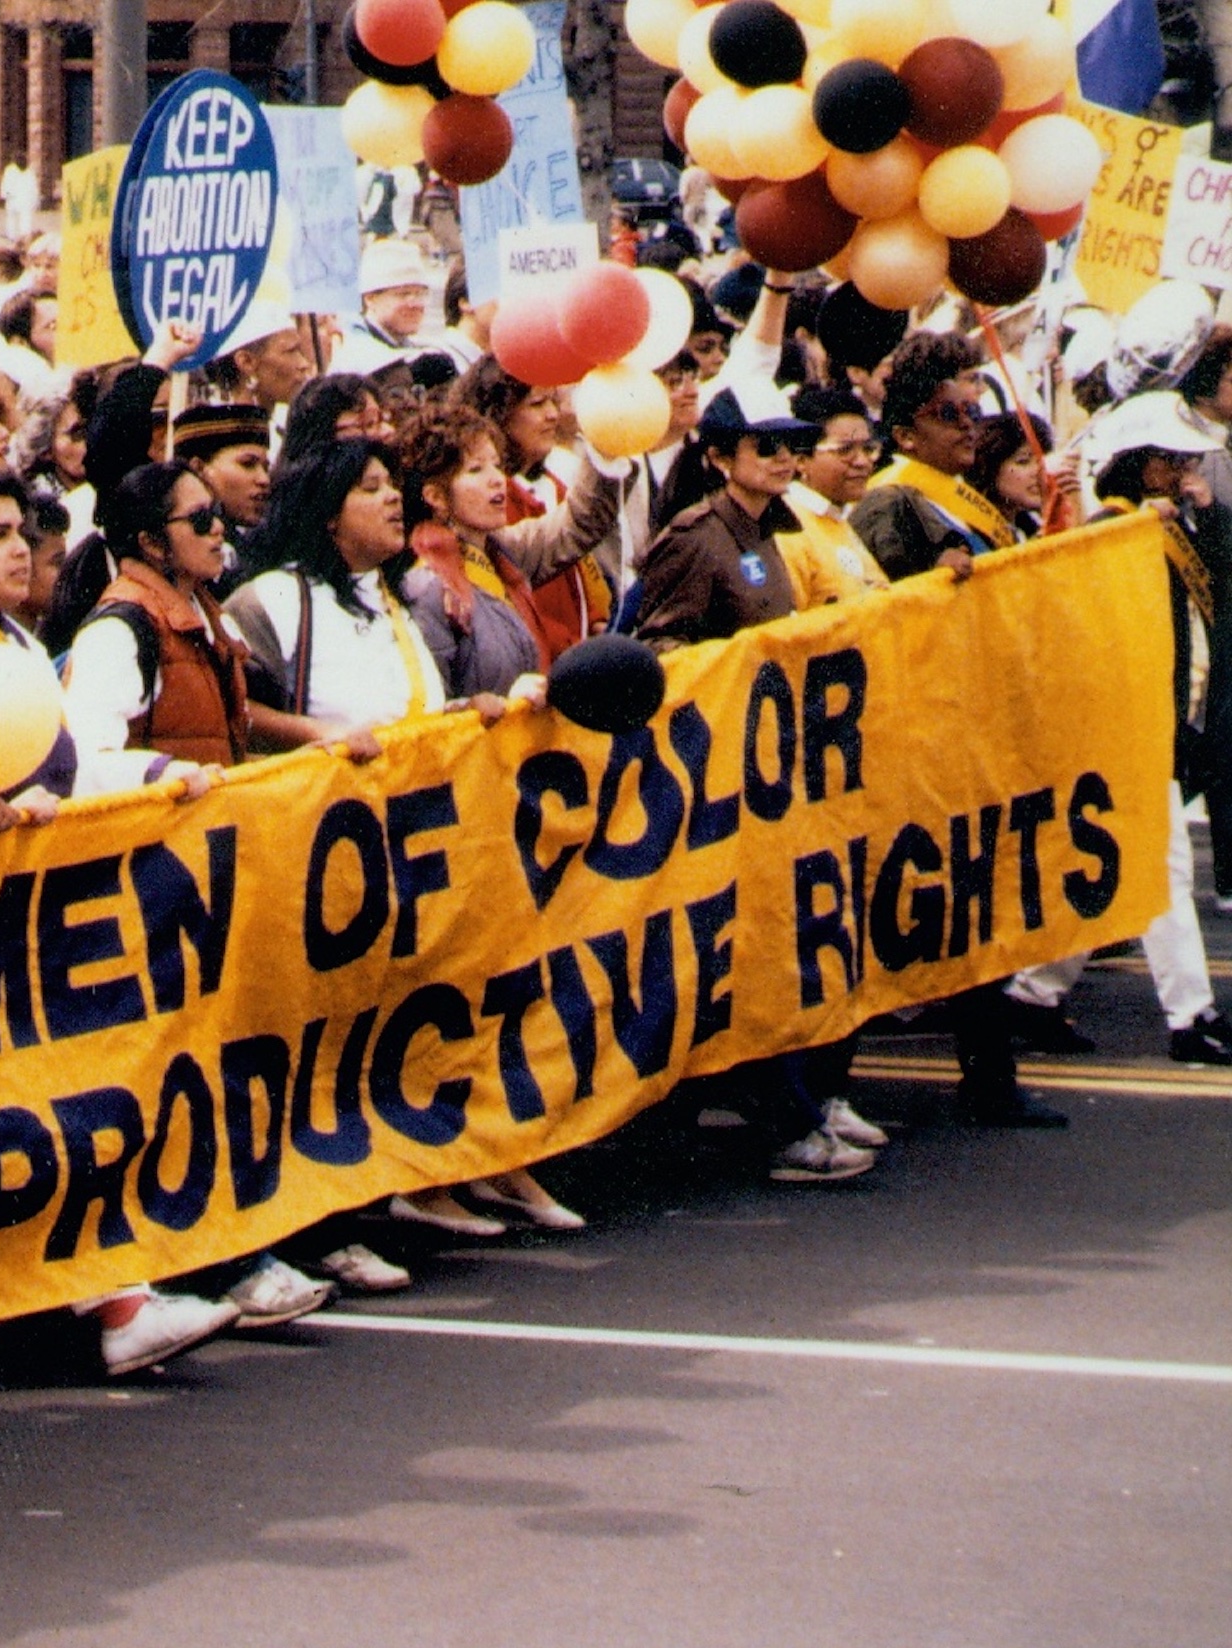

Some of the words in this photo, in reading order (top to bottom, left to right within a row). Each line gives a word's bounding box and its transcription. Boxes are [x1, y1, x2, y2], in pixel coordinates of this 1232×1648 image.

[165, 87, 255, 169] KEEP
[137, 170, 271, 257] ABORTION
[1116, 175, 1172, 217] ARE
[143, 253, 249, 333] LEGAL
[509, 248, 578, 275] AMERICAN
[955, 484, 993, 517] MARCH
[304, 783, 458, 974] OF
[515, 648, 866, 910] COLOR
[795, 773, 1120, 1008] RIGHTS
